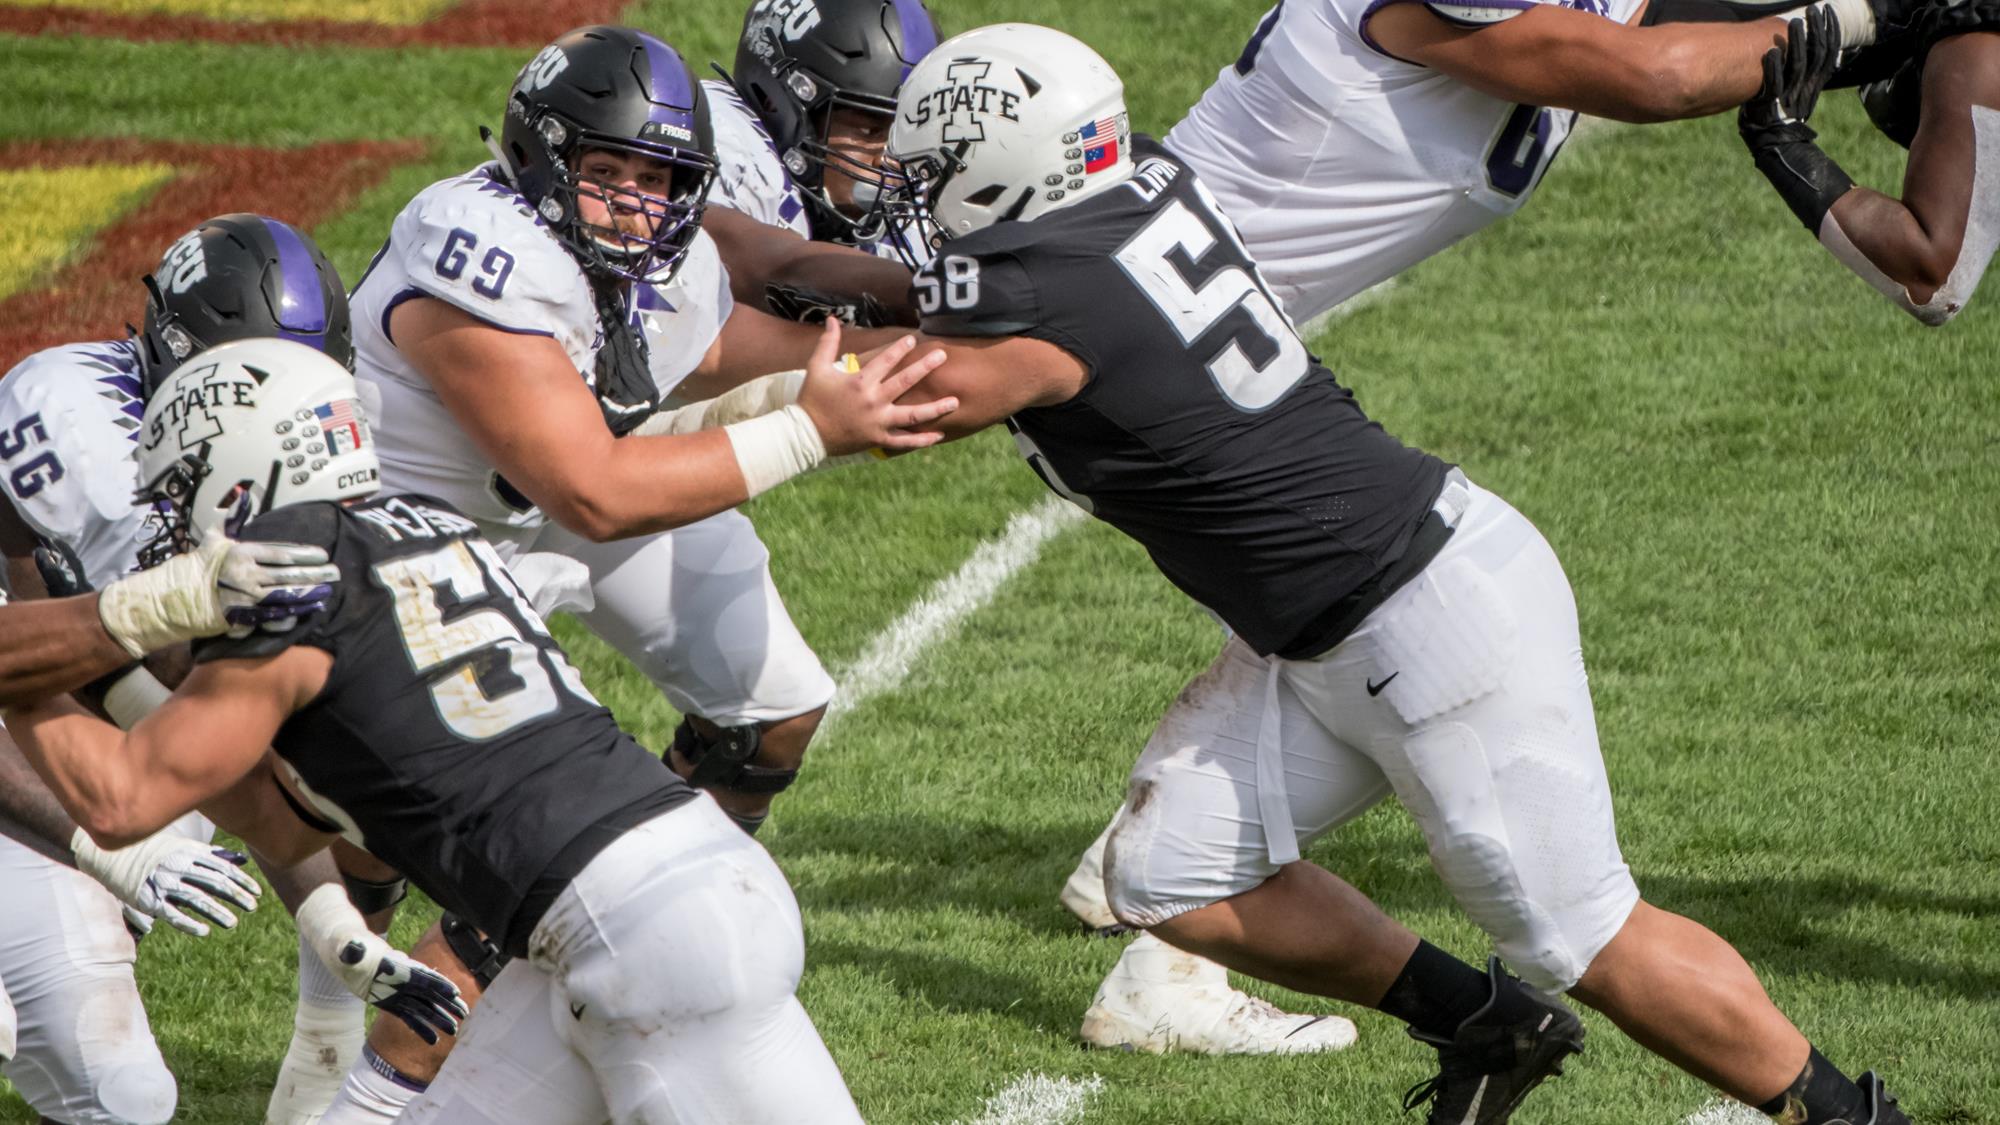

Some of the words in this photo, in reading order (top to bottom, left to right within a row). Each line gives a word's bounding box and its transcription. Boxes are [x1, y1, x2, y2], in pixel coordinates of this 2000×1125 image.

[660, 123, 692, 142] FROGS
[904, 84, 1021, 128] STATE
[433, 226, 516, 301] 69
[912, 254, 979, 313] 58
[1109, 177, 1309, 414] 5
[144, 381, 257, 451] STATE
[0, 409, 65, 499] 56
[371, 537, 600, 744] 5
